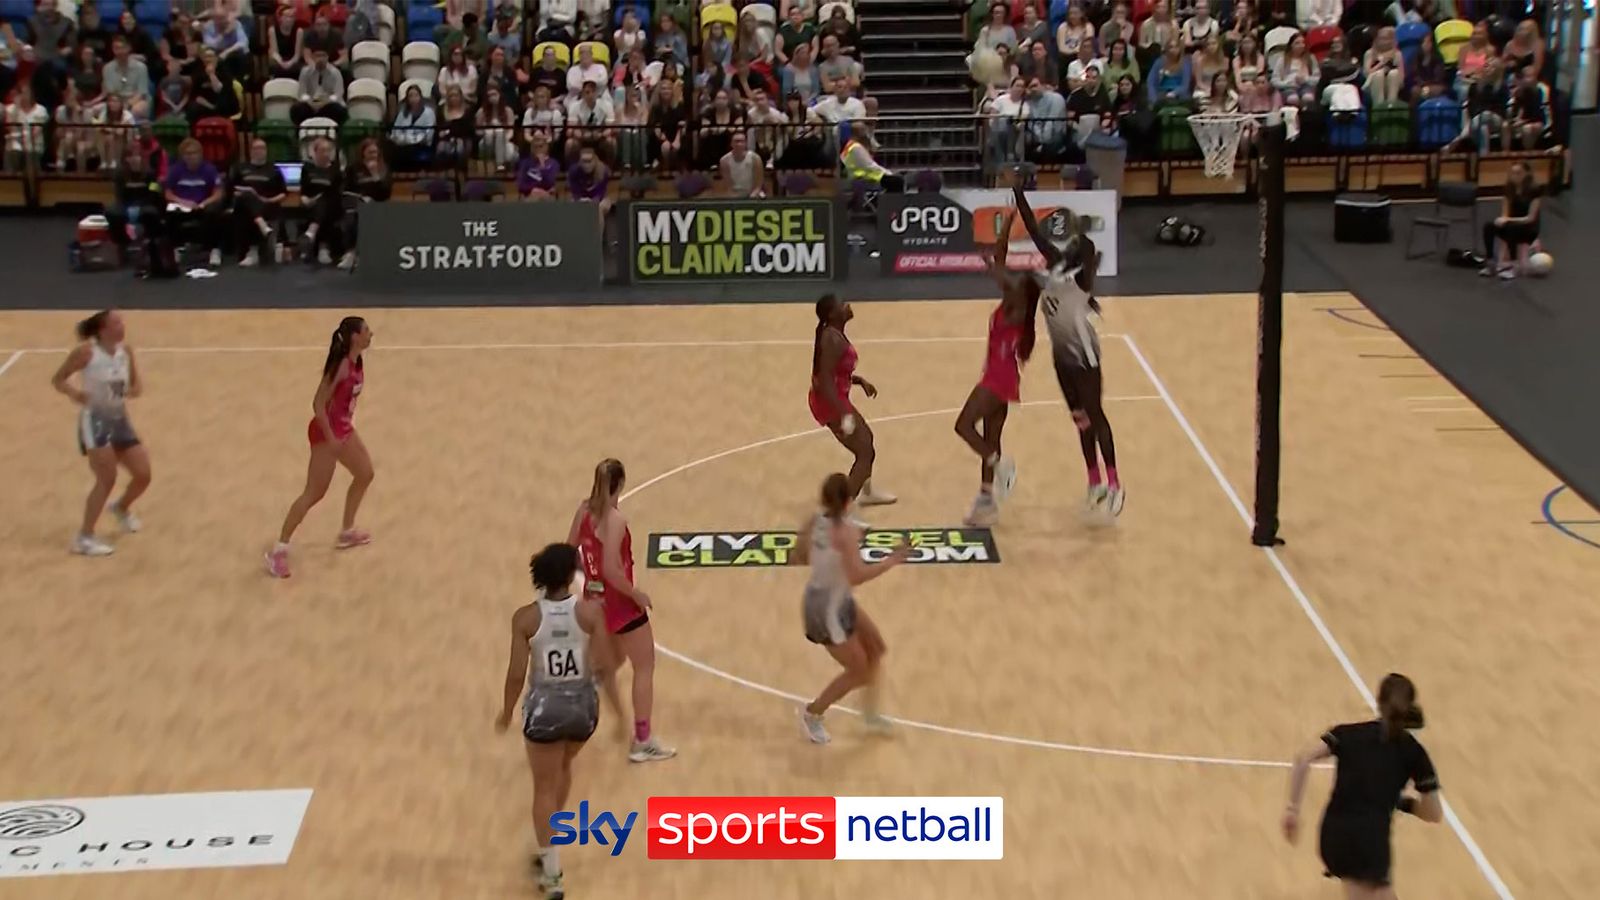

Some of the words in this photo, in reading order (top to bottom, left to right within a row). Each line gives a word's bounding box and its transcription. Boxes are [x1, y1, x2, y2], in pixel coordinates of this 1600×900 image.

[462, 220, 498, 237] THE
[637, 210, 825, 243] MYDIESEL
[399, 243, 563, 270] STRATFORD
[637, 243, 826, 275] CLAIM.COM
[899, 255, 938, 268] OFFICIAL
[547, 649, 579, 678] GA
[78, 834, 274, 854] HOUSE
